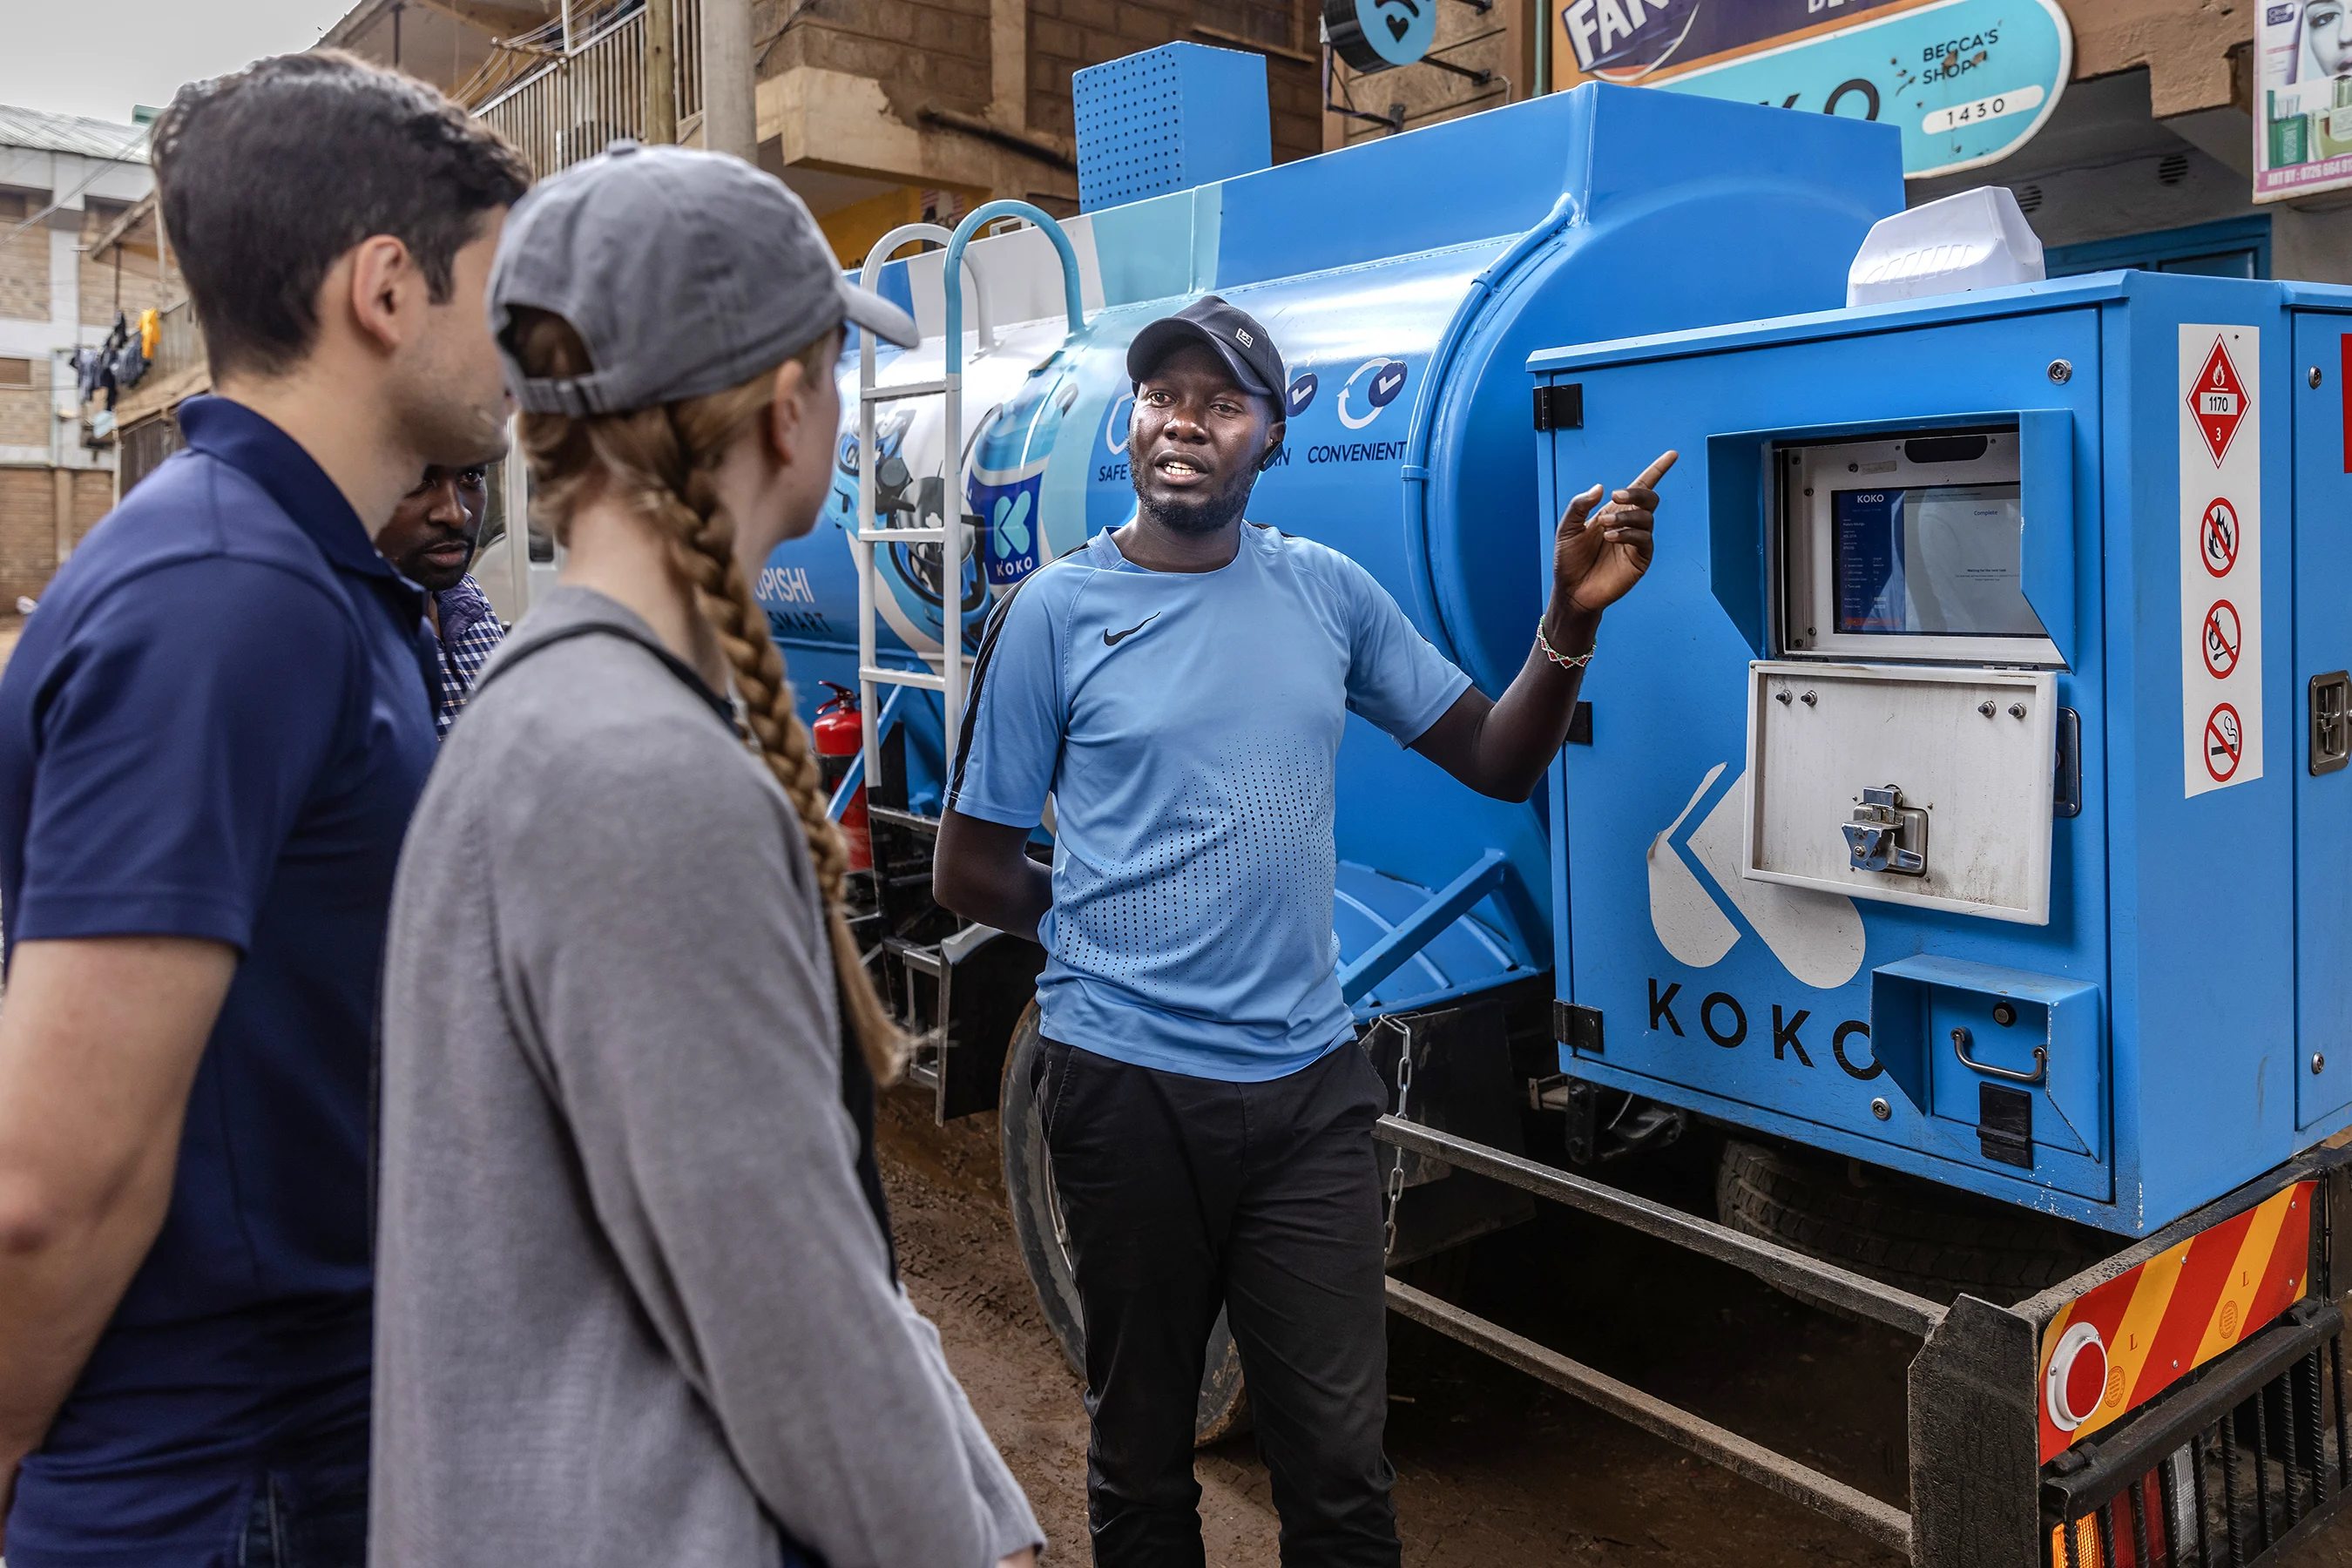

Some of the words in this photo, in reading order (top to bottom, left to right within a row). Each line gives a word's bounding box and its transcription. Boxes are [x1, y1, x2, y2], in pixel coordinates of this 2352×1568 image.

[1923, 29, 1999, 63] BECCA'S
[1923, 59, 1973, 84] SHOP
[1947, 98, 2004, 125] 1430
[2208, 395, 2229, 412] 1170
[2215, 427, 2221, 441] 3
[1098, 463, 1128, 482] SAFE
[1308, 441, 1408, 463] CONVENIENT
[1856, 494, 1884, 504] KOKO
[996, 556, 1033, 577] KOKO
[767, 610, 833, 633] SMART
[1647, 977, 1887, 1081] KOKO
[2242, 1271, 2250, 1288] L
[2129, 1333, 2139, 1351] L
